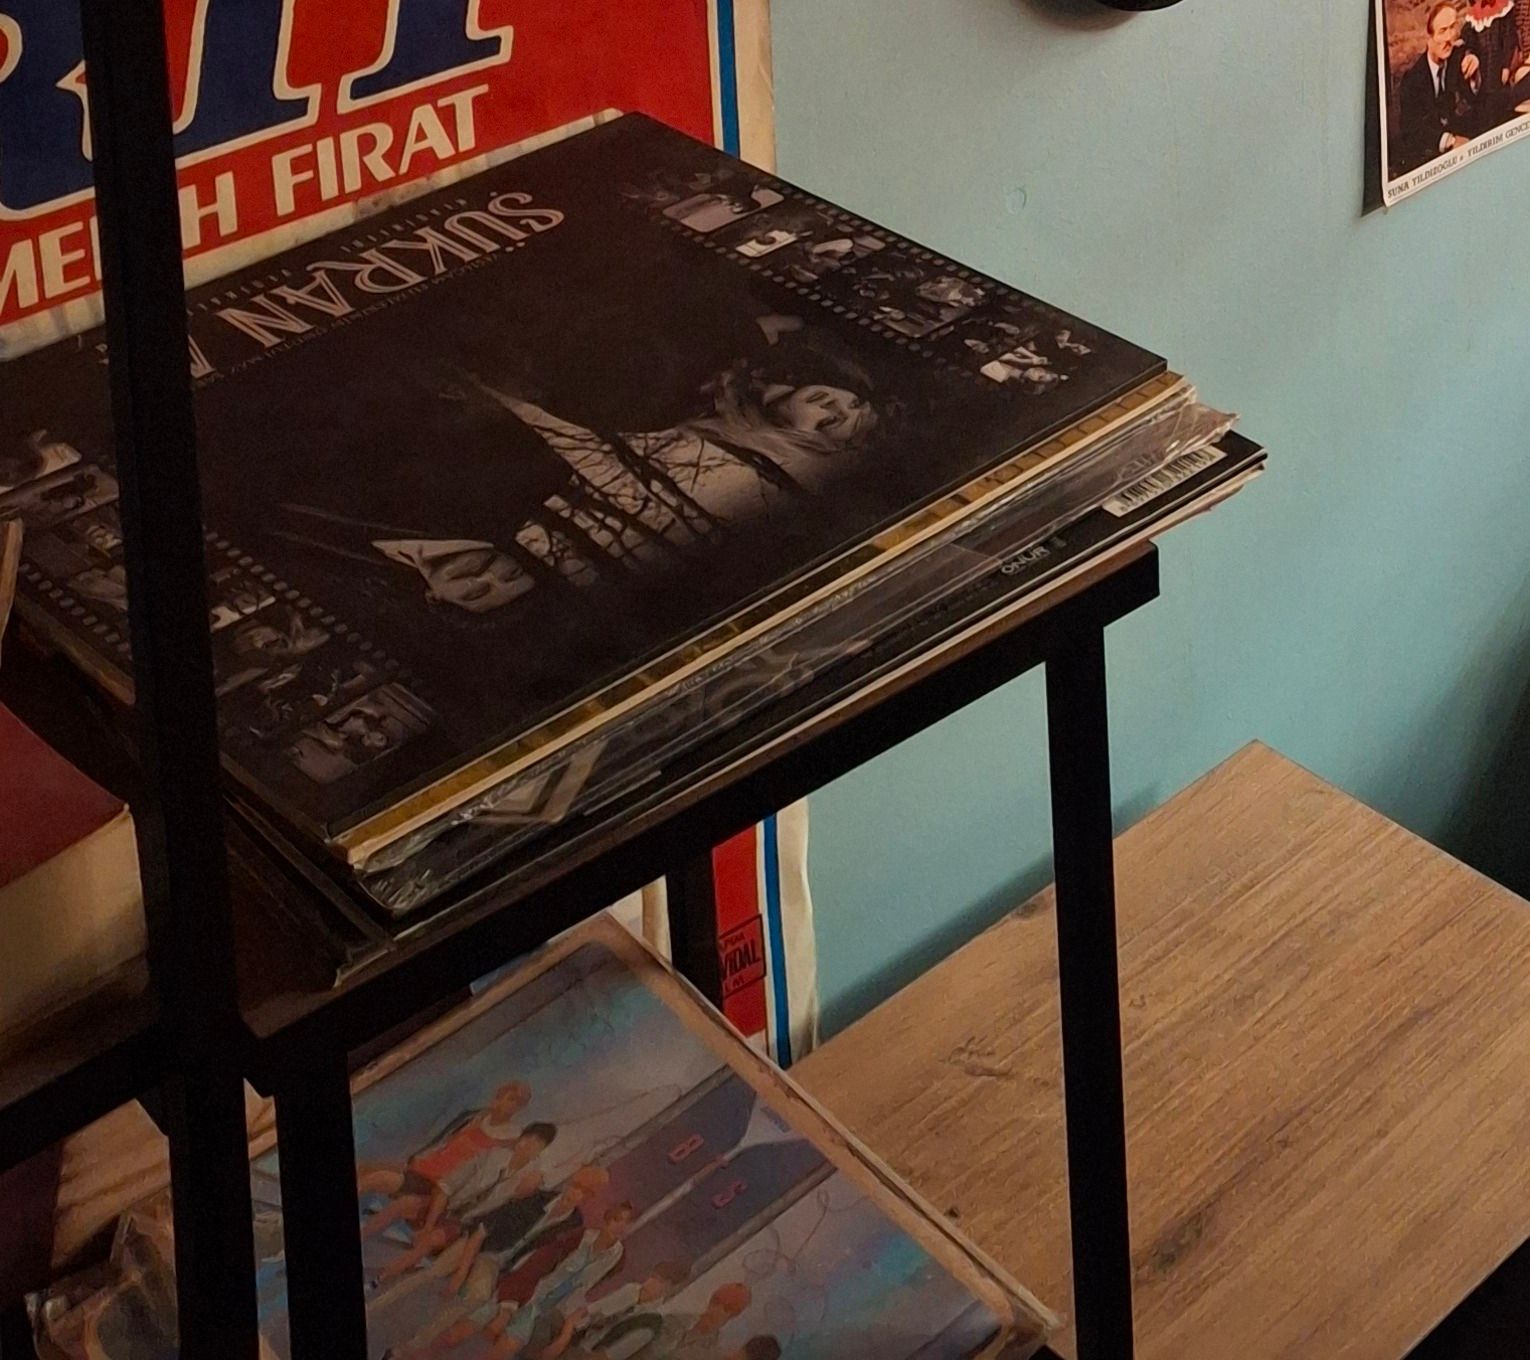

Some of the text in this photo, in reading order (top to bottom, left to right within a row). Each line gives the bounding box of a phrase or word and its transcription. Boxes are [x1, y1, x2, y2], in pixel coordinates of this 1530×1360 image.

[272, 82, 489, 217] FIRAT
[1387, 181, 1411, 200] SUNA
[216, 190, 566, 350] ŞÜKRAN
